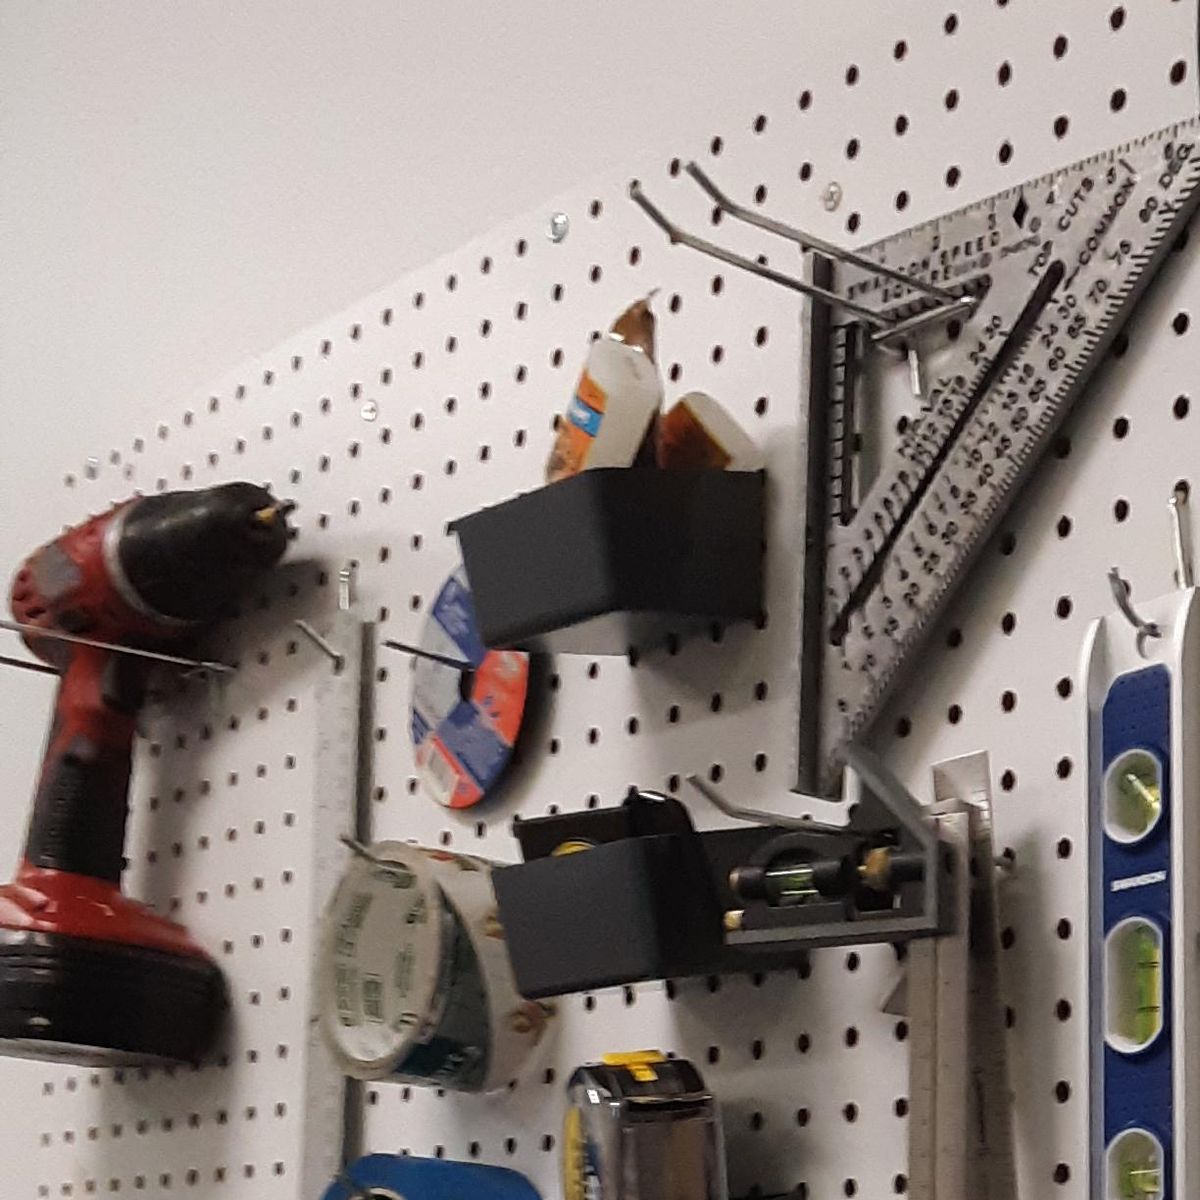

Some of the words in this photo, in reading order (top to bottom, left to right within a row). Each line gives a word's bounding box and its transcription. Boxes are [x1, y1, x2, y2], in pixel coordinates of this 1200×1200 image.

[1028, 240, 1053, 277] TOP
[1058, 177, 1095, 231] CUTS
[1078, 177, 1136, 266] COMMON
[940, 230, 1000, 266] SPEED
[1057, 295, 1077, 320] 30
[1086, 279, 1107, 305] 70
